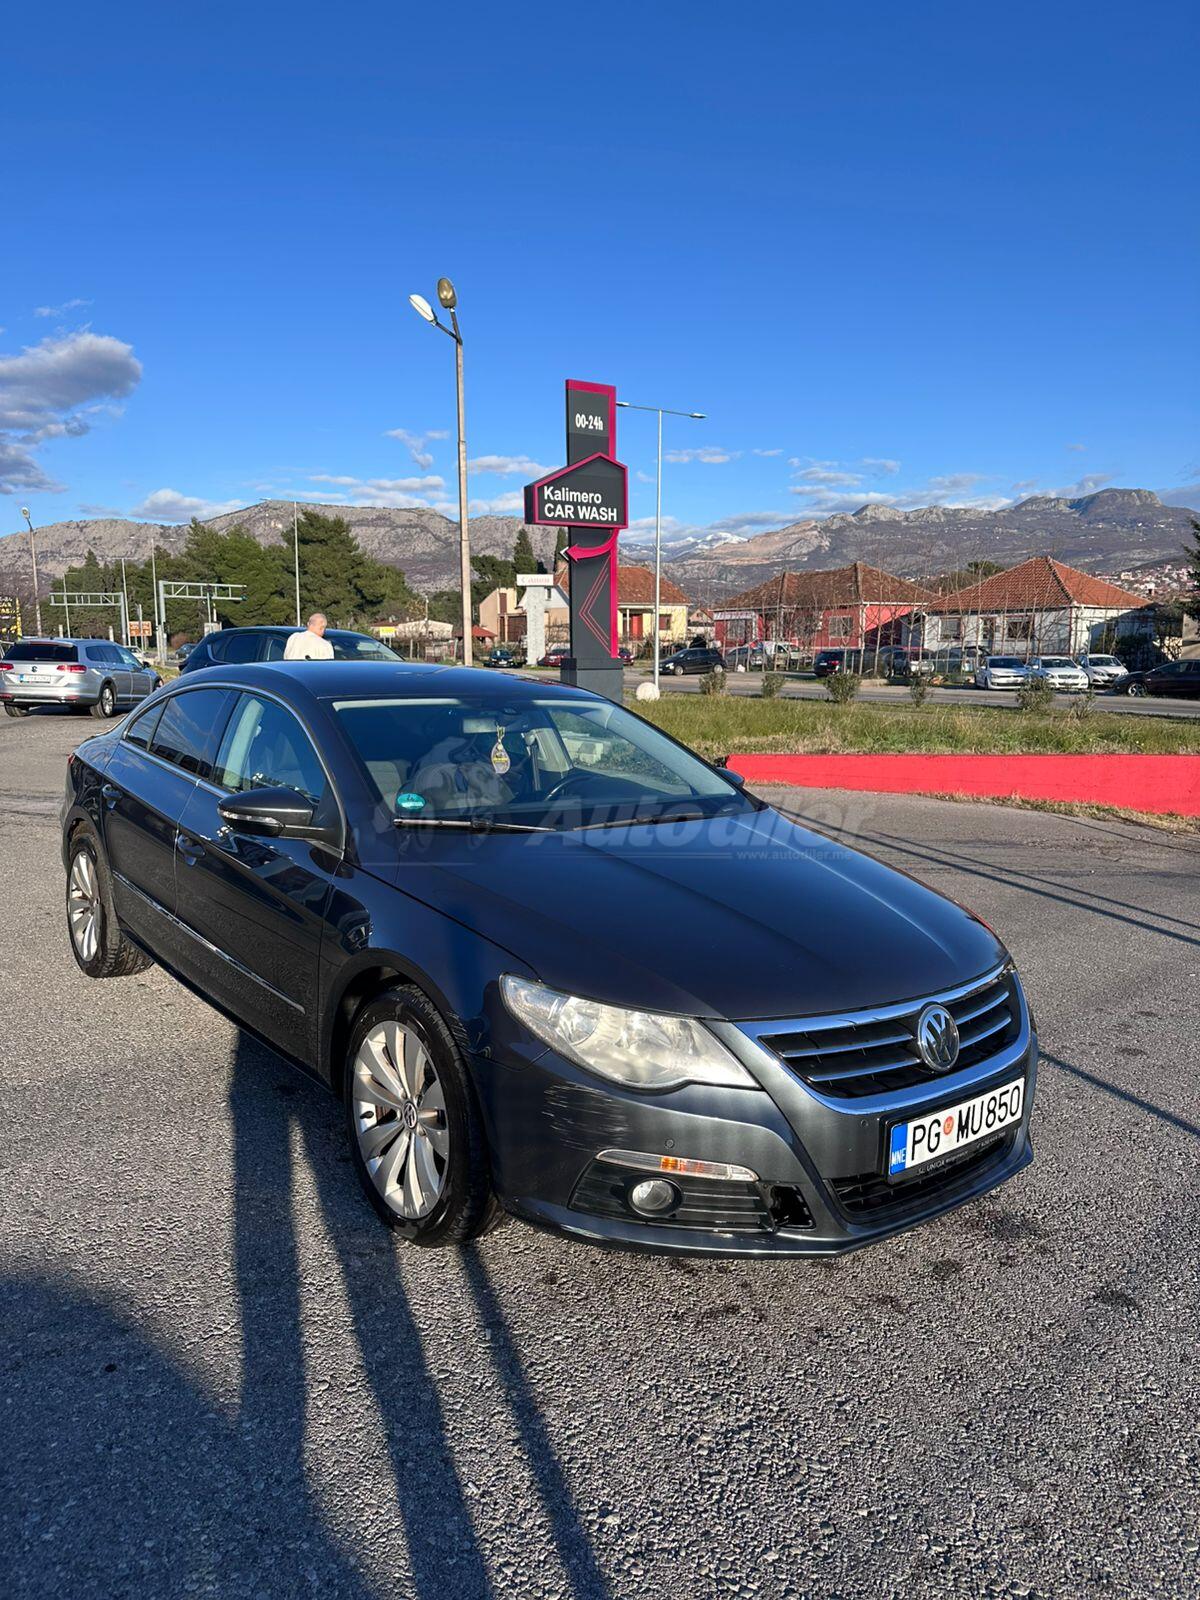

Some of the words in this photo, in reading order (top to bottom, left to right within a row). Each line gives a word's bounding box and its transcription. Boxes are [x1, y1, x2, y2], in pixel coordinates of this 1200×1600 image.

[575, 413, 604, 430] 00-24h
[543, 485, 602, 504] Kalimero
[544, 503, 575, 519] CAR
[577, 505, 617, 522] WASH
[911, 1118, 942, 1161] PG
[956, 1085, 1021, 1143] MU850
